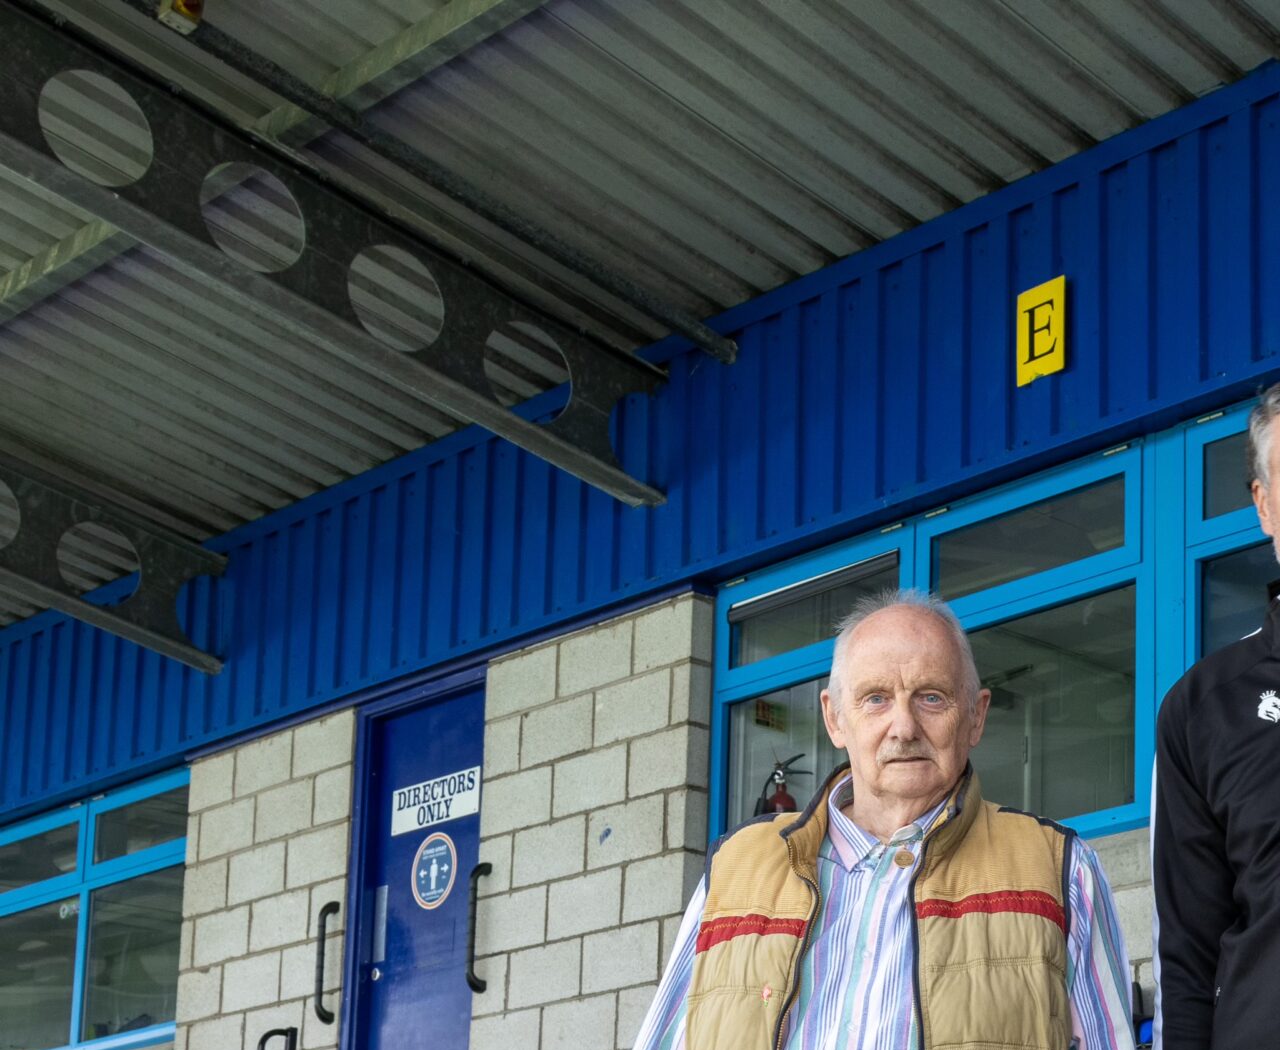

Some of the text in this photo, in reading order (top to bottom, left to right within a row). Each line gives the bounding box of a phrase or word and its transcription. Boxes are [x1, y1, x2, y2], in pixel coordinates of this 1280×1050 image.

[1023, 298, 1057, 365] E
[397, 770, 475, 811] DIRECTORS
[417, 798, 453, 826] ONLY
